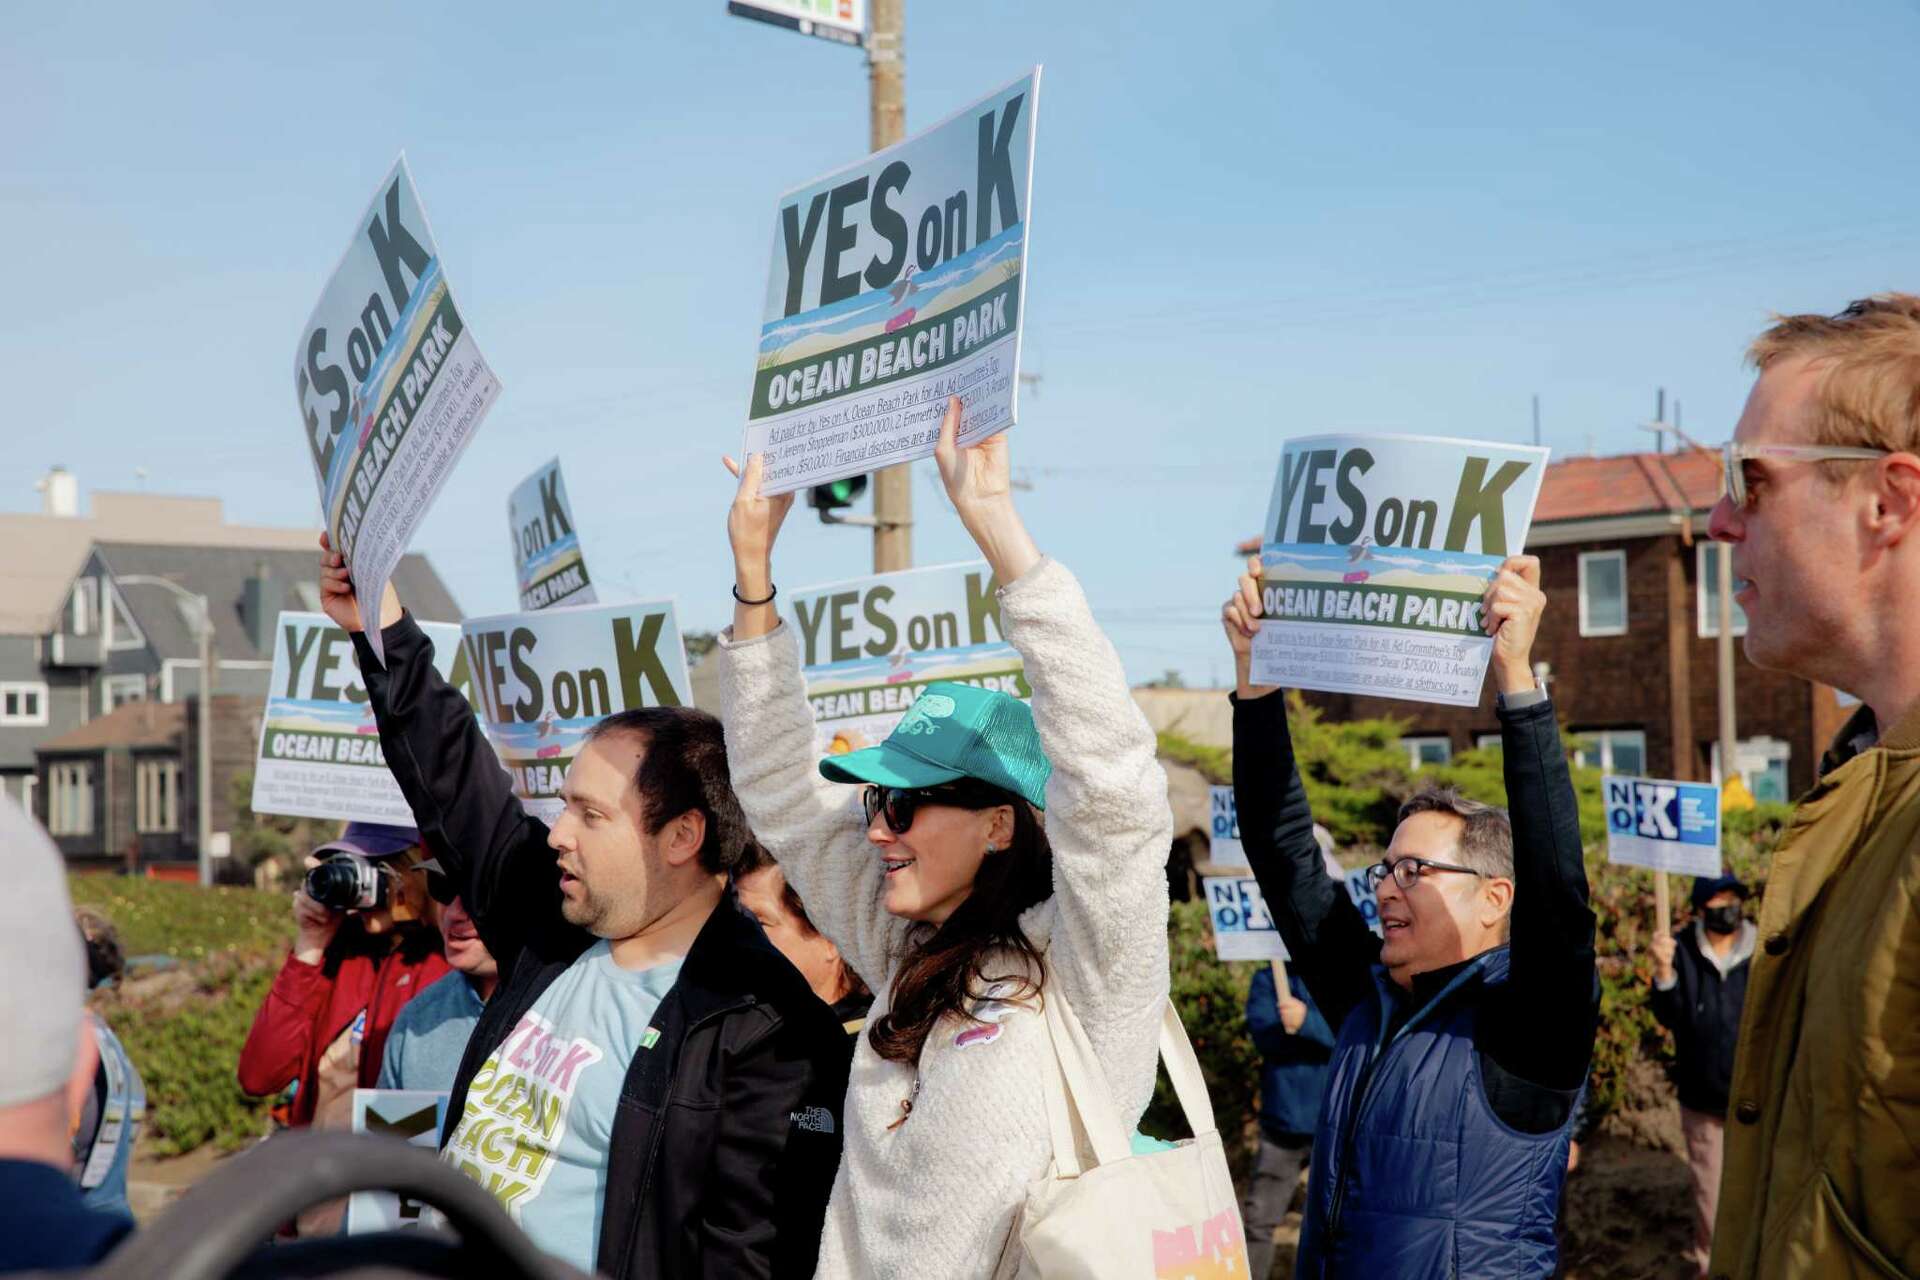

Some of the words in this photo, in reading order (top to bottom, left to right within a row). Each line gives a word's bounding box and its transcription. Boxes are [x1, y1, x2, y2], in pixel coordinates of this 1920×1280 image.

[368, 176, 432, 320] K
[782, 161, 911, 318] YES
[917, 190, 967, 271] on
[976, 93, 1025, 242] K
[347, 292, 392, 382] on
[768, 354, 854, 409] OCEAN
[860, 323, 947, 384] BEACH
[952, 292, 1008, 355] PARK
[299, 327, 350, 486] ES
[355, 397, 408, 504] BEACH
[402, 314, 454, 411] PARK
[876, 393, 899, 413] Beach
[901, 387, 918, 406] Park
[523, 517, 545, 558] on
[539, 469, 571, 543] K
[1275, 448, 1375, 546] YES
[1374, 497, 1438, 549] on
[1444, 456, 1532, 557] K
[794, 586, 898, 666] YES
[908, 611, 958, 651] on
[965, 573, 1004, 644] K
[1263, 587, 1320, 617] OCEAN
[1323, 589, 1398, 622] BEACH
[1402, 595, 1482, 631] PARK
[466, 627, 544, 723] YES
[552, 665, 611, 720] on
[612, 613, 680, 709] K
[815, 692, 865, 719] CEAN
[272, 733, 334, 761] OCEAN
[1636, 785, 1678, 839] K
[469, 1059, 561, 1141] OCEAN
[549, 1044, 593, 1092] K
[805, 1106, 821, 1114] THE
[790, 1112, 821, 1122] NORTH
[798, 1122, 822, 1131] FACE
